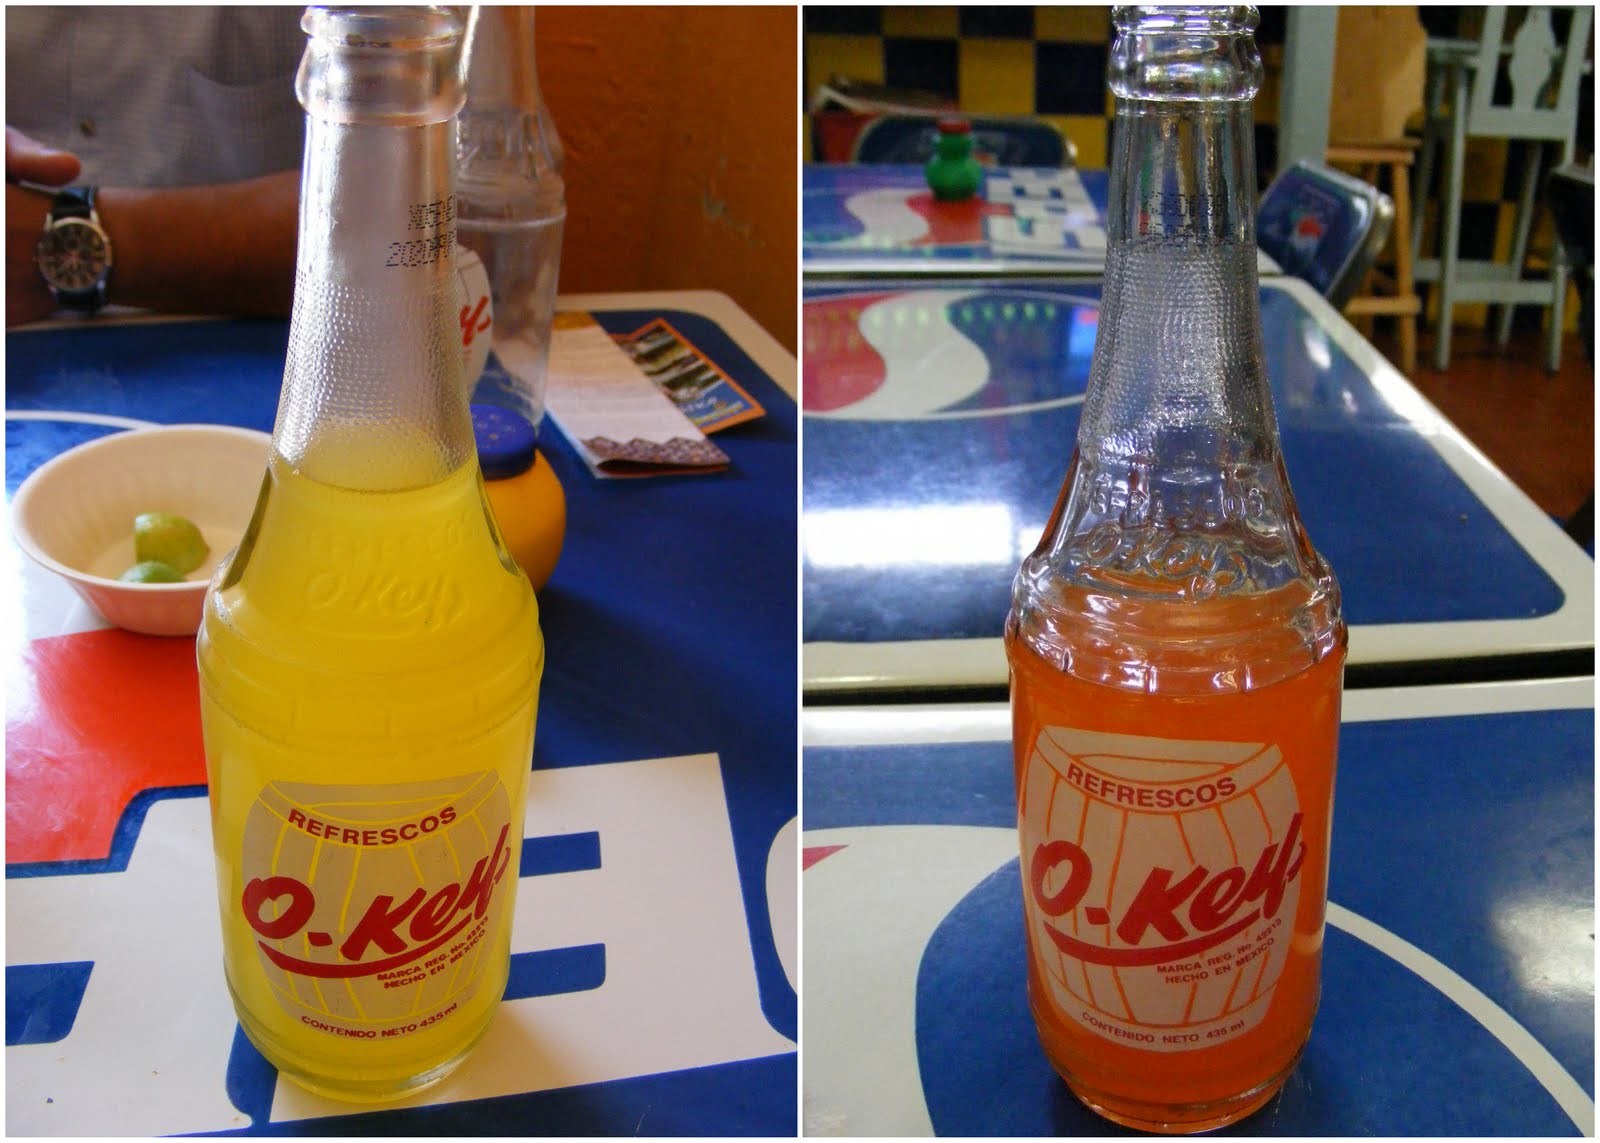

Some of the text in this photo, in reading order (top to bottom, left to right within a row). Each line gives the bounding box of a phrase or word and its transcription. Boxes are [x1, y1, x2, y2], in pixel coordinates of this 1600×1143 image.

[1067, 762, 1237, 808] REFRESCOS
[288, 806, 457, 846] REFRESCOS
[377, 965, 422, 981] MARCA
[425, 953, 450, 970] REG.
[384, 929, 486, 990] HECHO EN MEXICO
[1156, 960, 1202, 974] MARCA
[1207, 952, 1235, 967] REG.
[1165, 937, 1275, 985] HECHO EN MEXICO
[301, 1014, 377, 1039] CONTENIDO
[381, 1023, 418, 1037] NETO
[1081, 1011, 1246, 1044] CONTENIDO NETO 435 ml
